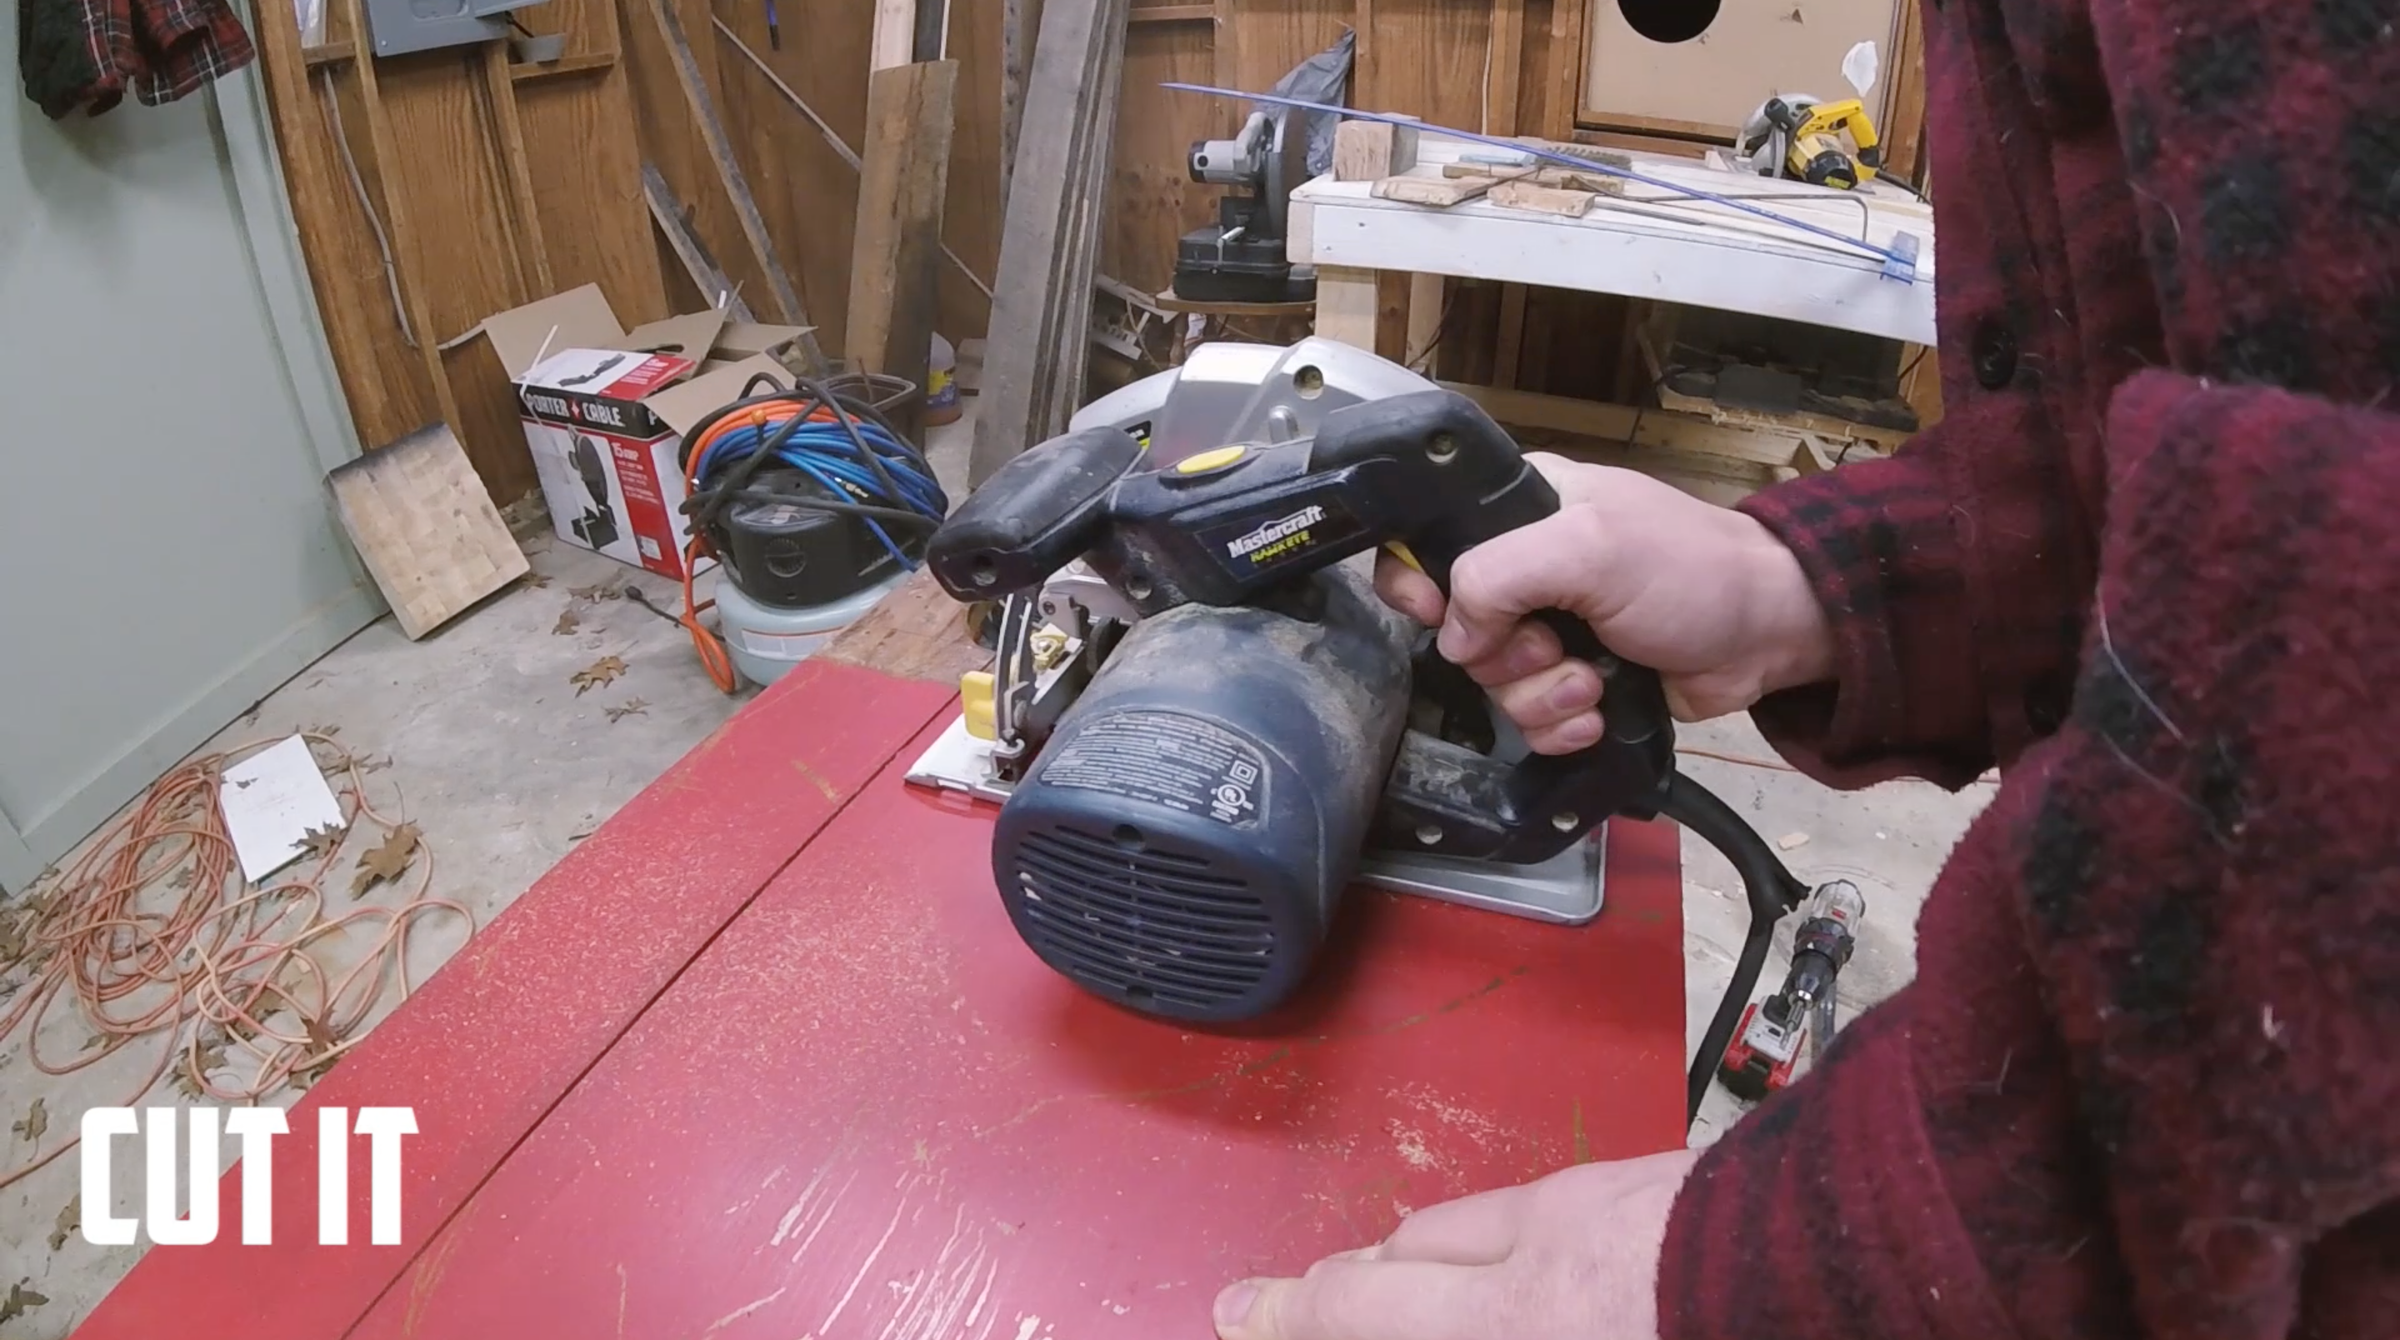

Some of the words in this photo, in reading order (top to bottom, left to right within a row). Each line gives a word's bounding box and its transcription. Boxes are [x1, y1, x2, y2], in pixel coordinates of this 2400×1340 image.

[525, 392, 570, 418] PORTER
[582, 401, 625, 427] CABLE
[1227, 505, 1323, 558] Mastercraft
